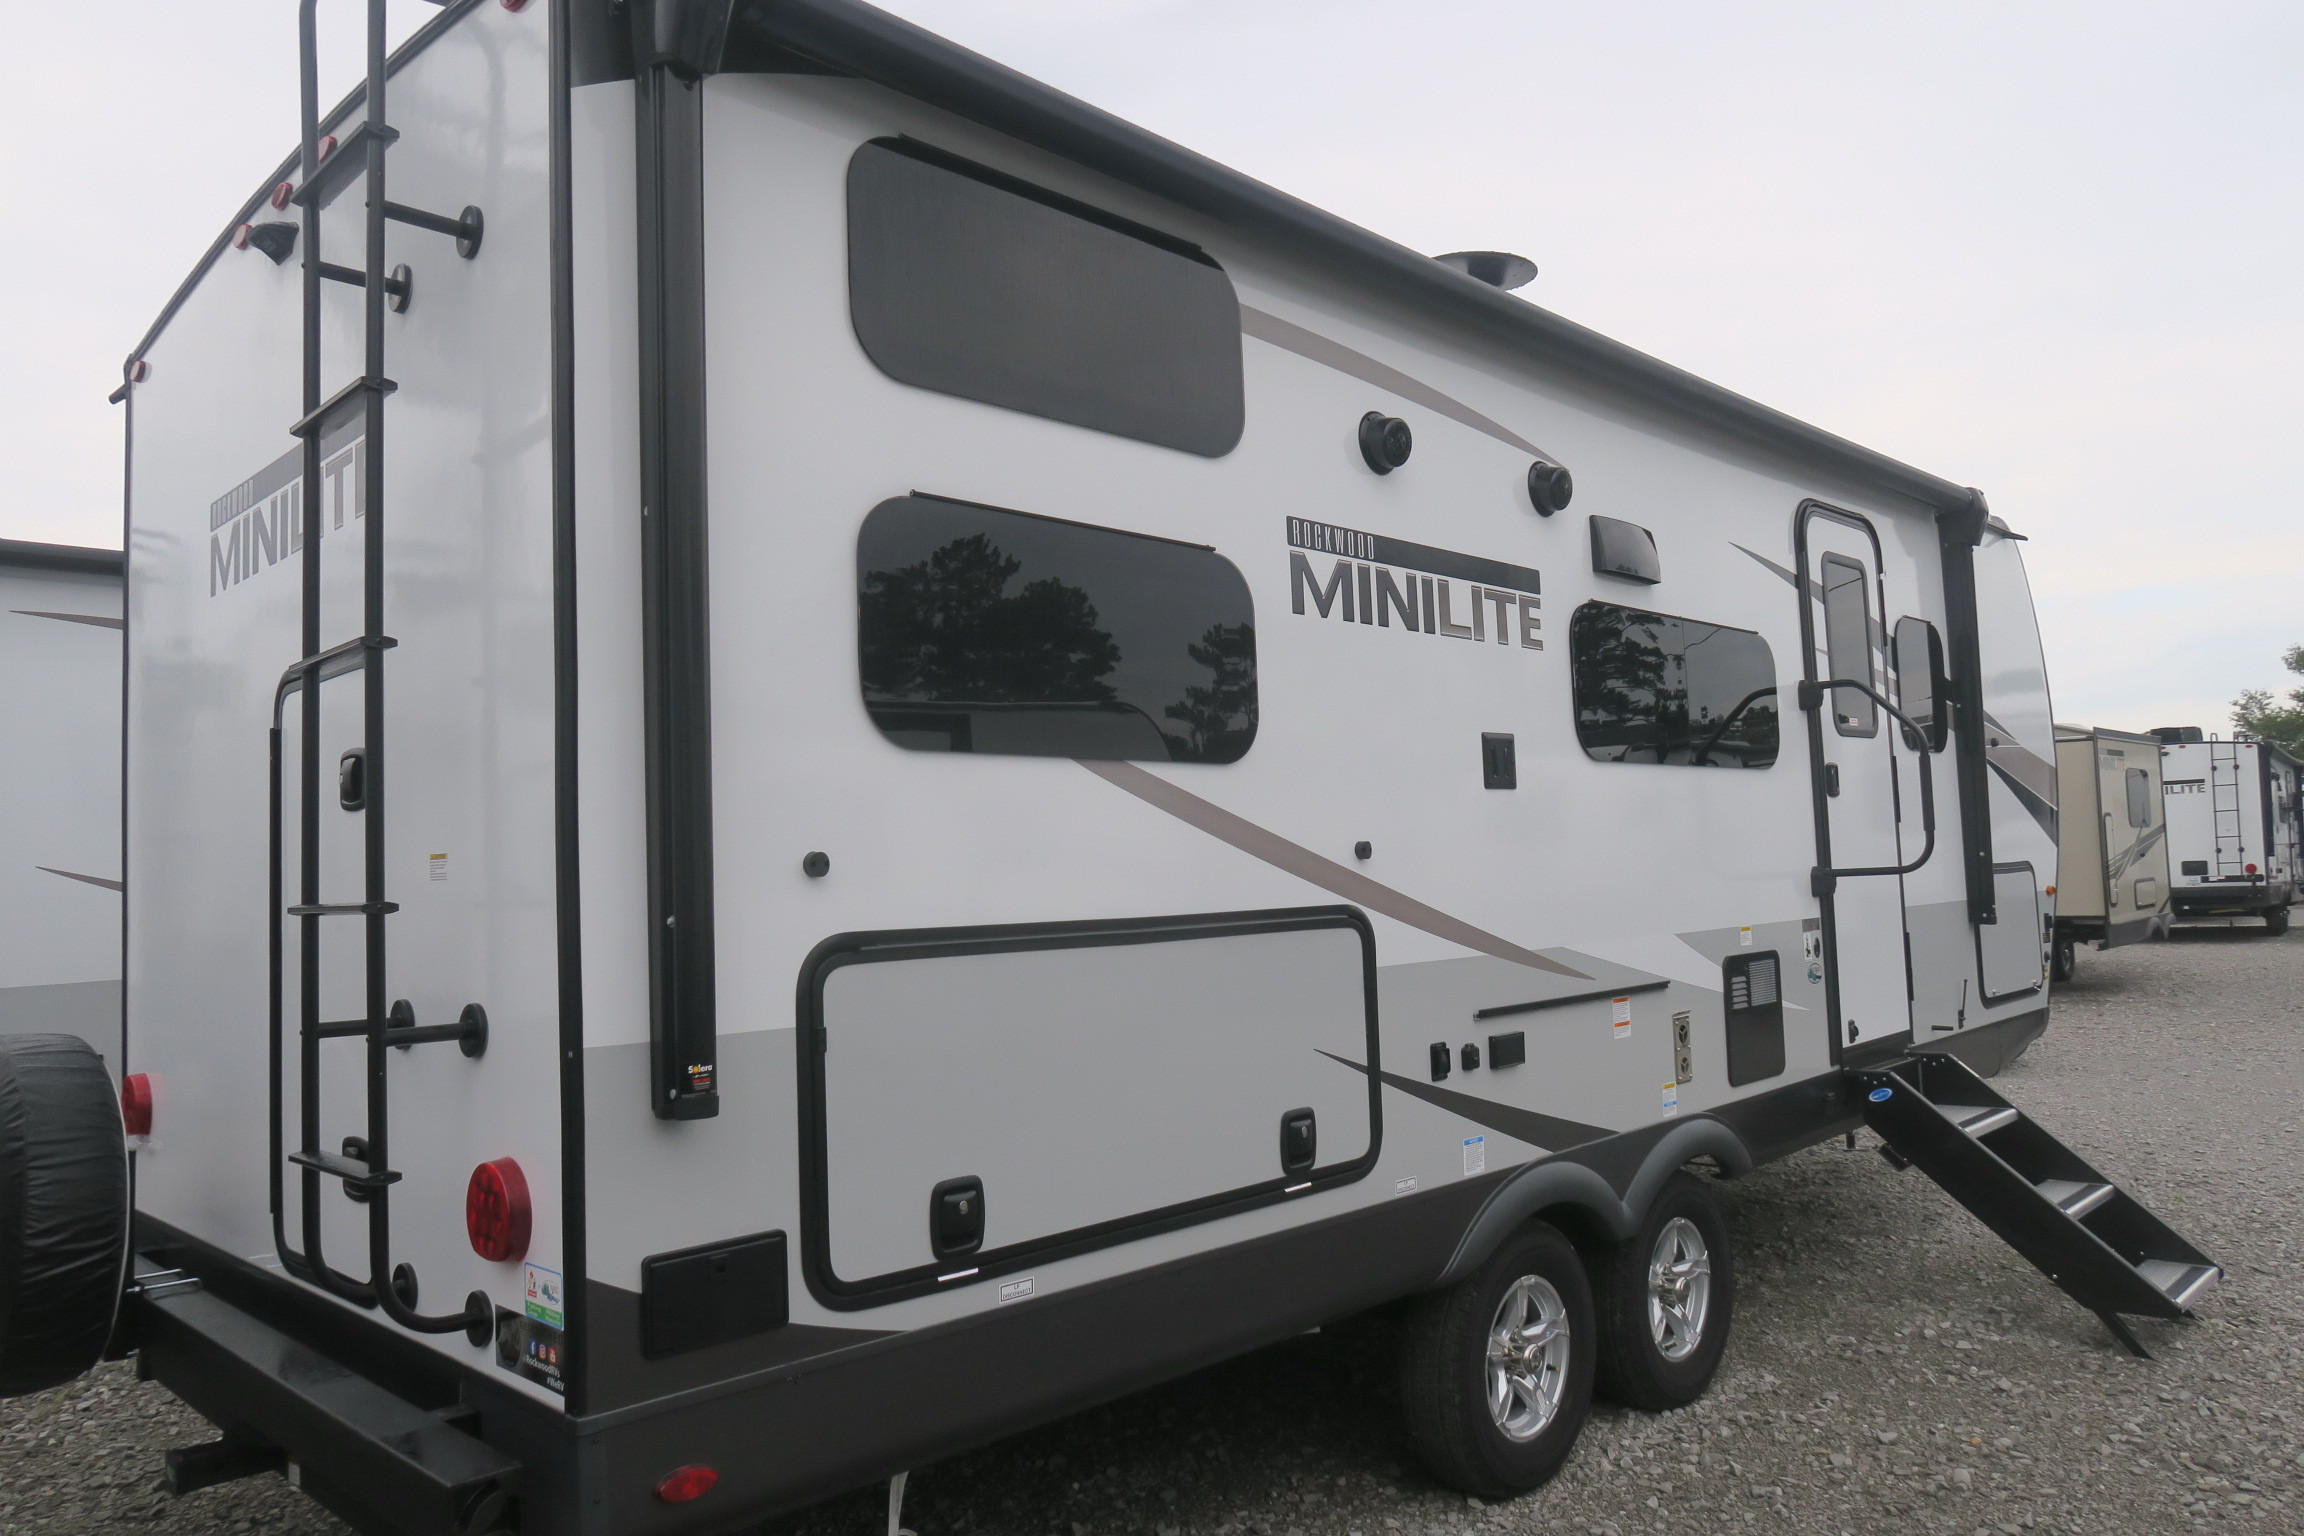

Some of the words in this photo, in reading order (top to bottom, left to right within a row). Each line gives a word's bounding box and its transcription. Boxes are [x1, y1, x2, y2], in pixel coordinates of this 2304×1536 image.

[210, 437, 366, 598] MINILT
[1291, 518, 1375, 560] ROCKWOOD
[1289, 549, 1544, 651] MINILITE
[2164, 783, 2206, 795] ILITE
